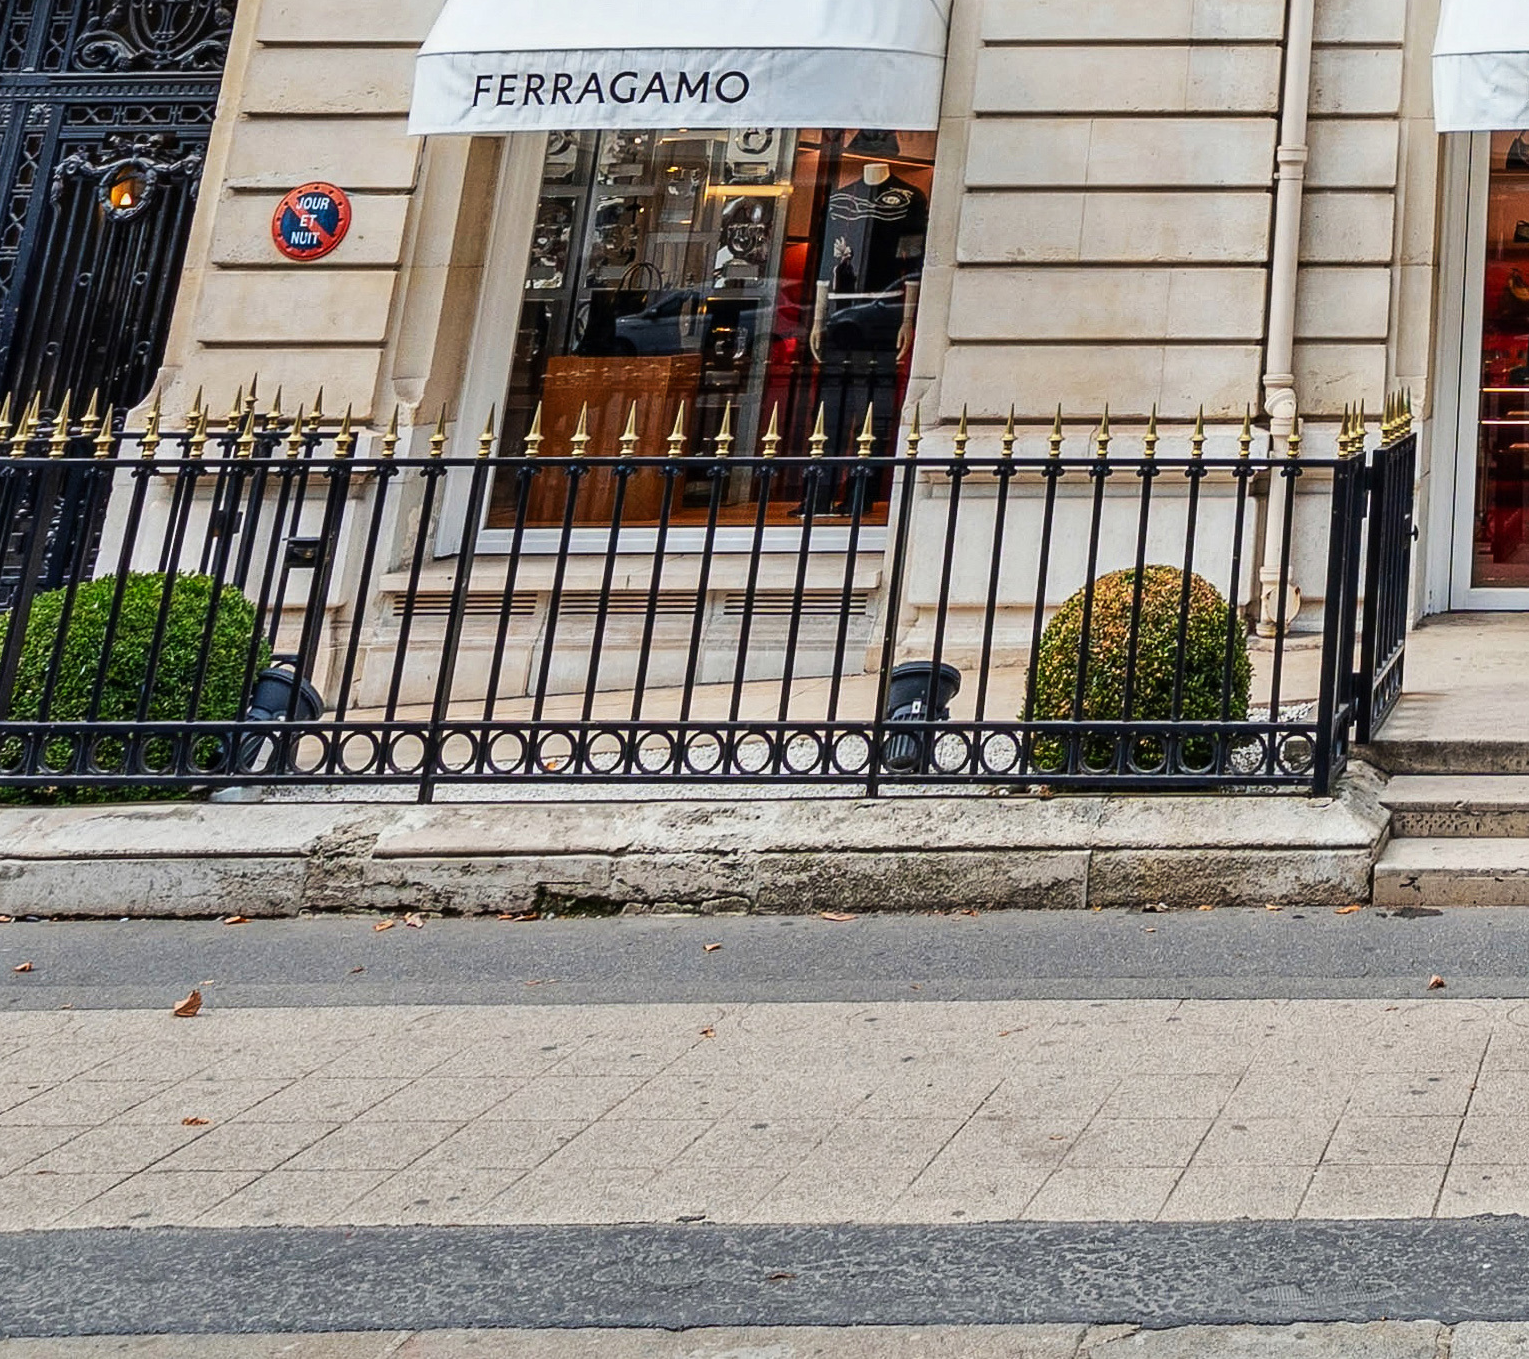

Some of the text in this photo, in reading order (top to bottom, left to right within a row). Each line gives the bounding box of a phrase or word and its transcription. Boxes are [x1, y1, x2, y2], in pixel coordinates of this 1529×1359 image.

[472, 72, 749, 107] FERRAGAMO
[295, 197, 330, 210] JOUR
[299, 214, 317, 227] ET
[291, 231, 320, 245] NUIT
